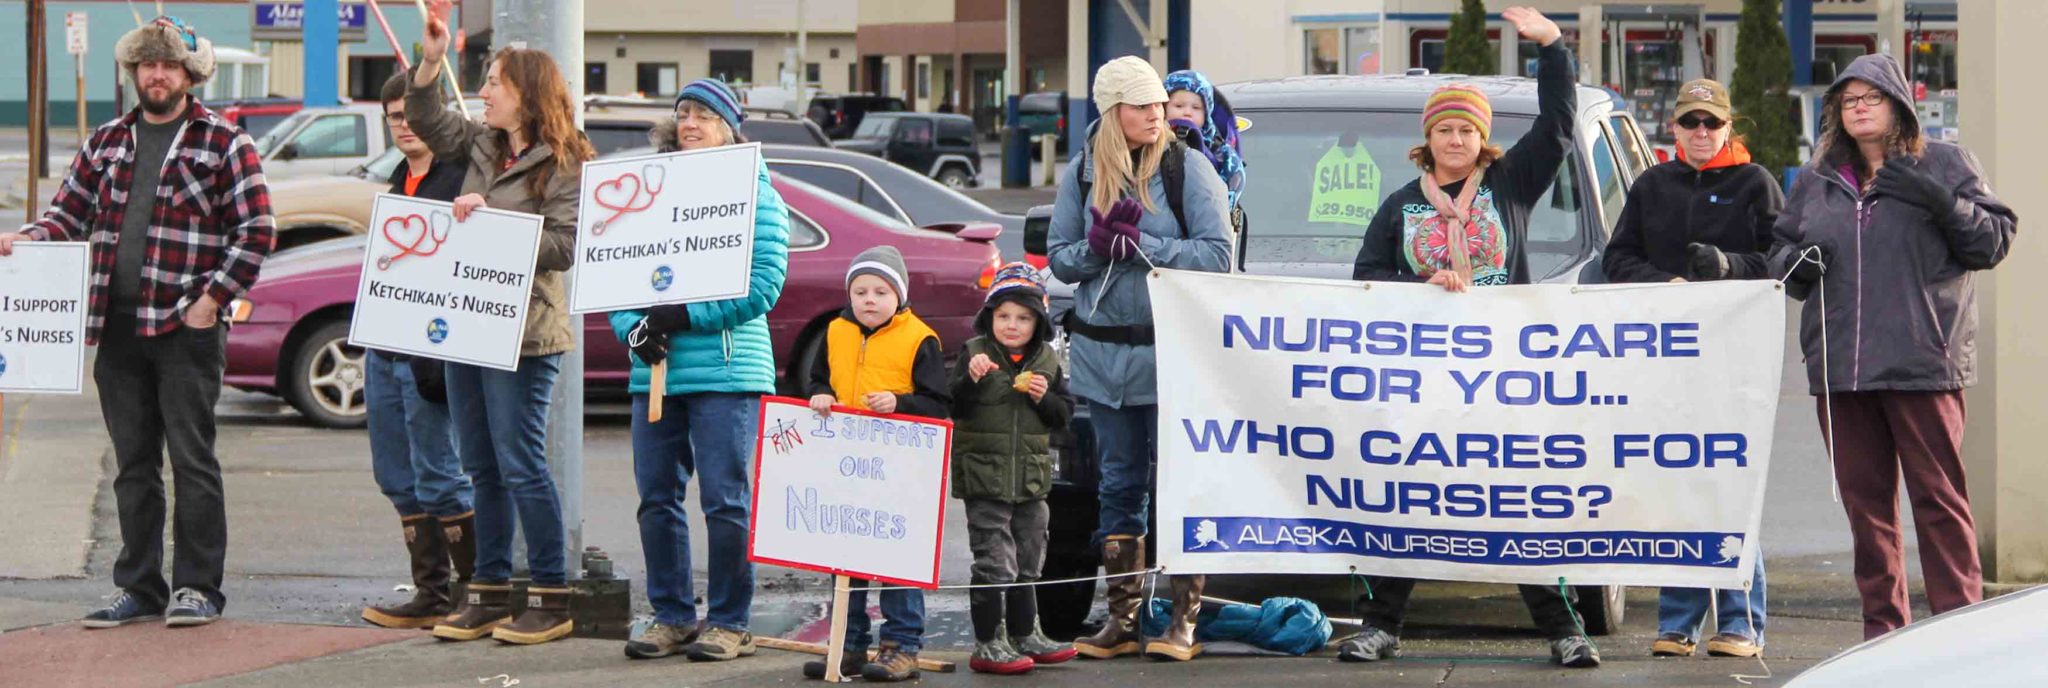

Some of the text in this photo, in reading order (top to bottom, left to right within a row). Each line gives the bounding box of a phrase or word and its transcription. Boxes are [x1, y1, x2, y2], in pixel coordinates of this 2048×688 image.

[1319, 163, 1374, 194] SALE!
[672, 202, 747, 223] I SUPPORT
[586, 234, 742, 263] KETCHIKAN'S NURSES
[452, 261, 525, 287] I SUPPORT
[3, 295, 78, 313] I SUPPORT
[368, 280, 517, 319] KETCHIKAN'S NURSES
[17, 327, 74, 344] NURSES
[1223, 314, 1700, 359] NURSES CARE
[1291, 363, 1629, 406] FOR YOU...
[811, 413, 938, 449] I SUPPORT
[1182, 418, 1748, 469] WHO CARES FOR
[839, 455, 886, 481] OUR
[786, 484, 907, 540] NURSES
[1306, 474, 1613, 520] NURSES?
[1237, 524, 1703, 559] ALASKA NURSES ASSOCIATION
